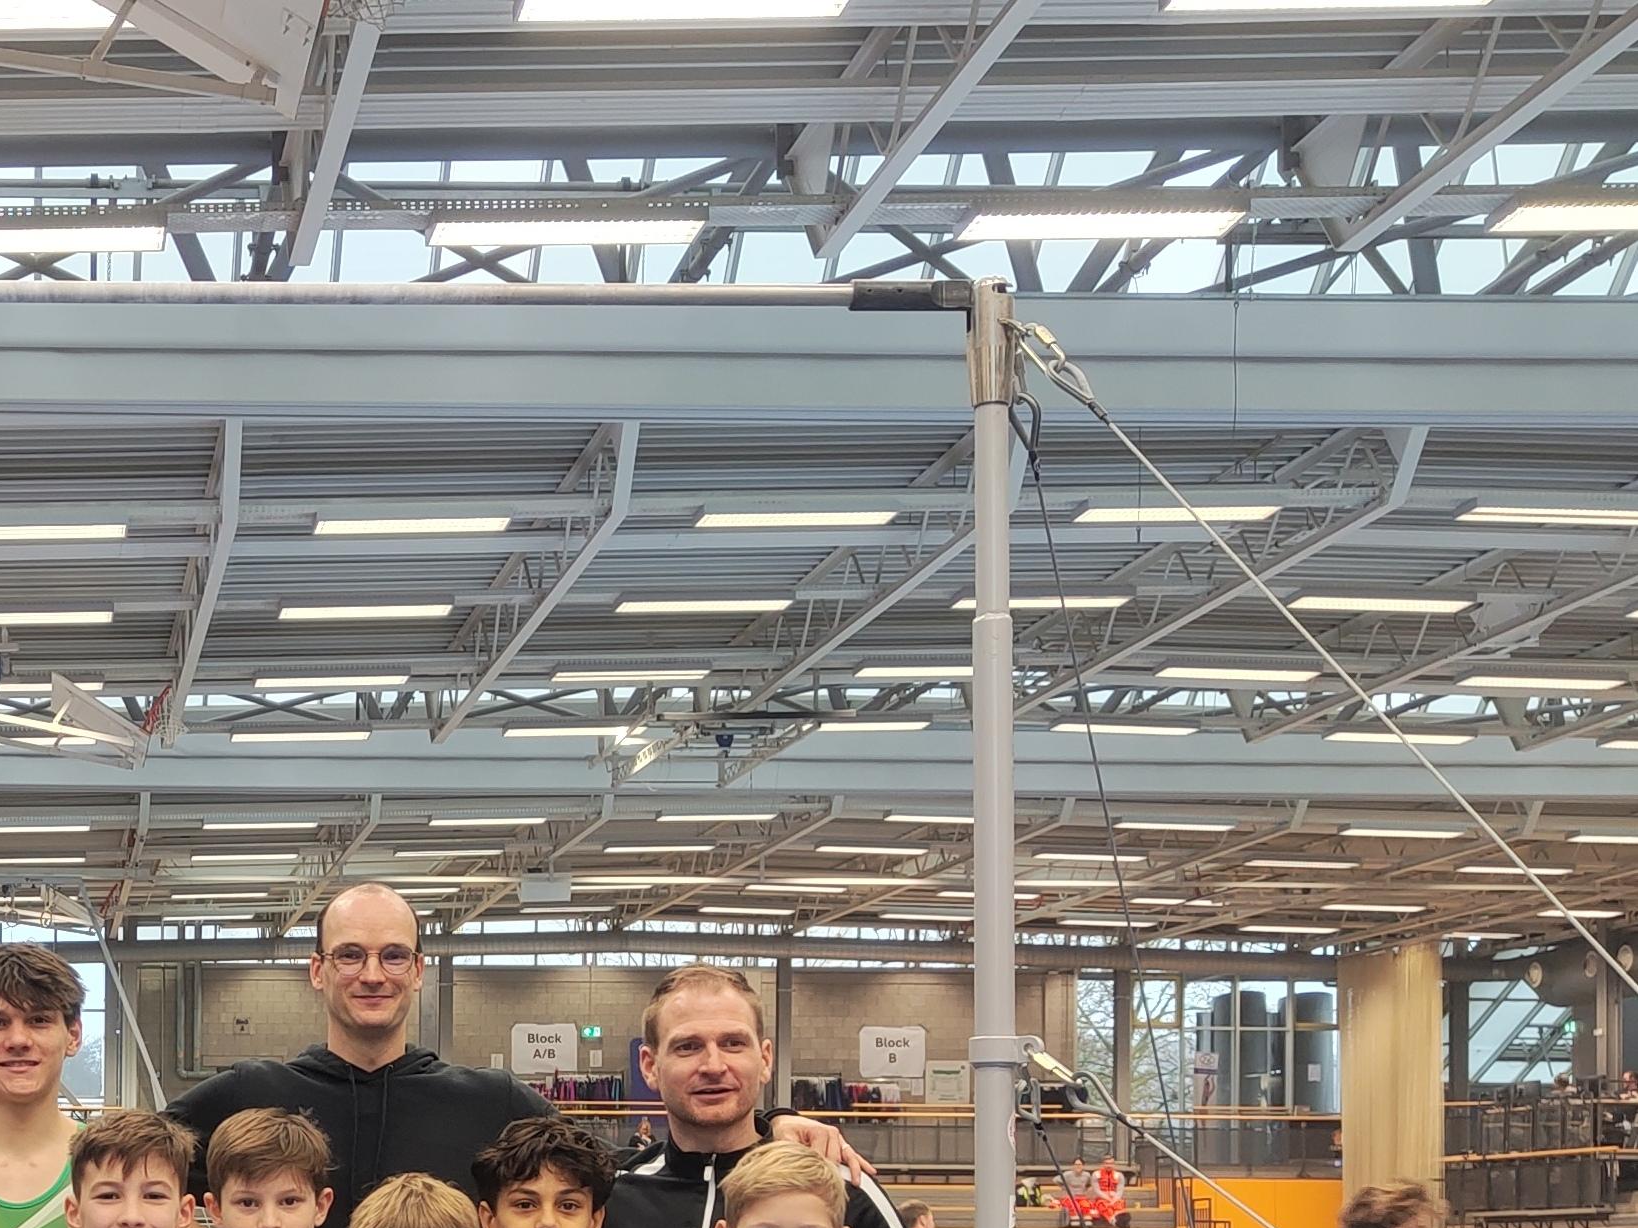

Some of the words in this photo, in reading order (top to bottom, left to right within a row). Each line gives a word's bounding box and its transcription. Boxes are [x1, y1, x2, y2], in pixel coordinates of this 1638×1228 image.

[527, 1033, 562, 1044] Block
[875, 1037, 910, 1048] Block
[533, 1048, 556, 1059] A/B
[889, 1053, 897, 1064] B
